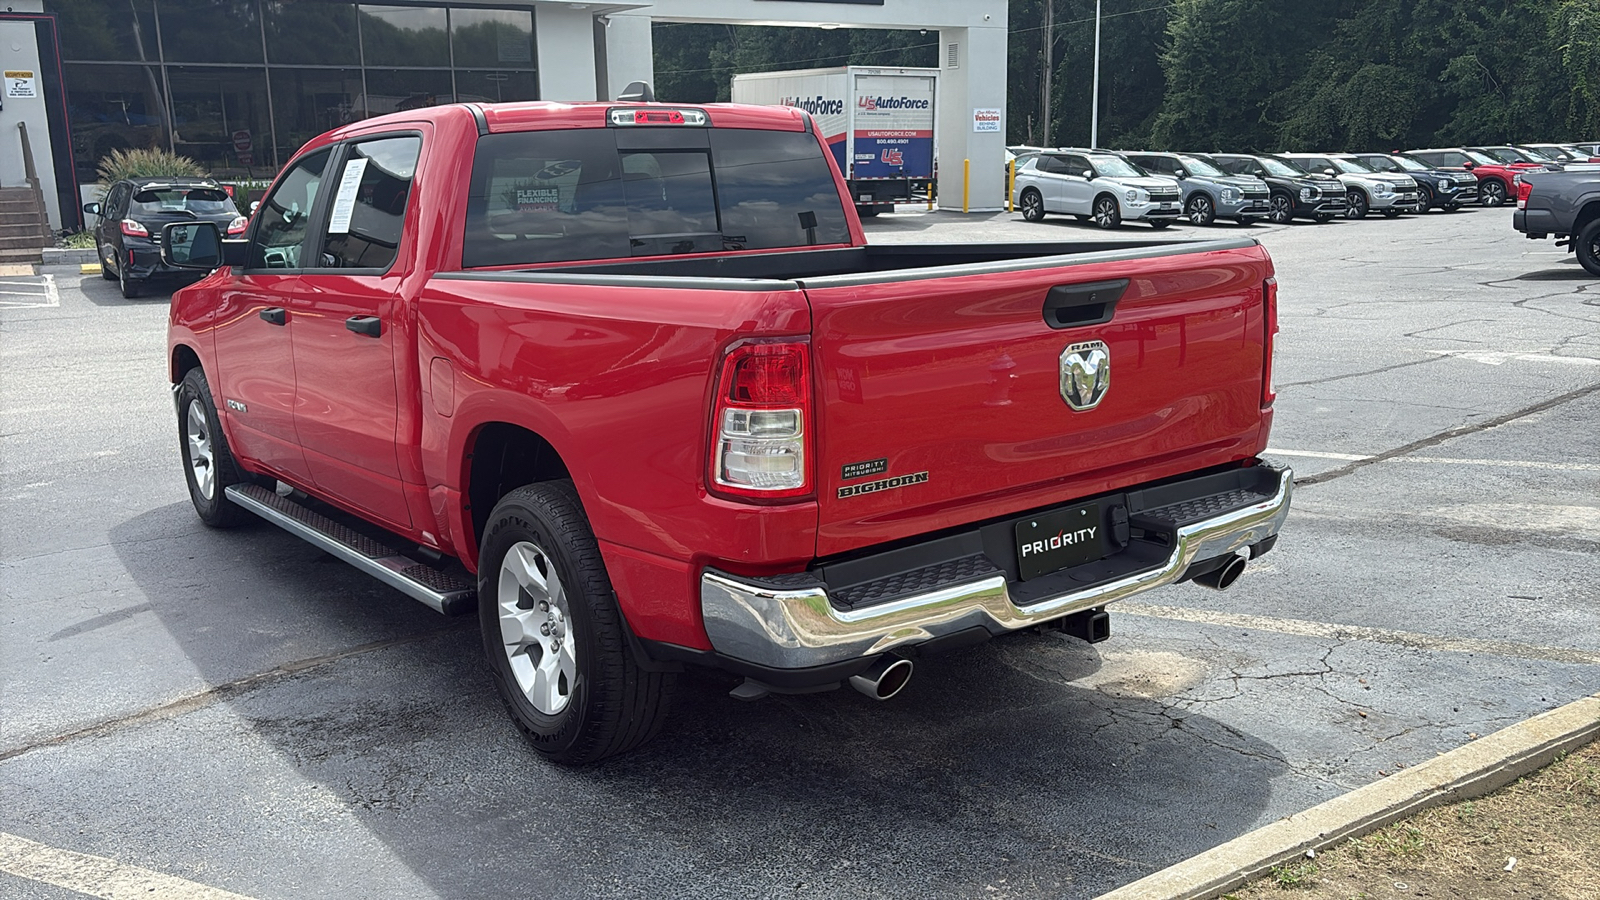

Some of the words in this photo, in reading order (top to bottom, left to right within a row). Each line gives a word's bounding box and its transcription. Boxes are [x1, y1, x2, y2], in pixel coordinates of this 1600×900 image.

[517, 188, 558, 198] FLEXIBLE
[517, 196, 559, 204] FINANCING
[1071, 341, 1103, 351] RAM
[844, 460, 885, 473] PRIORITY
[844, 466, 884, 477] MITSUBISHI
[838, 471, 929, 499] BIGHORN
[1021, 526, 1097, 557] PRIORITY
